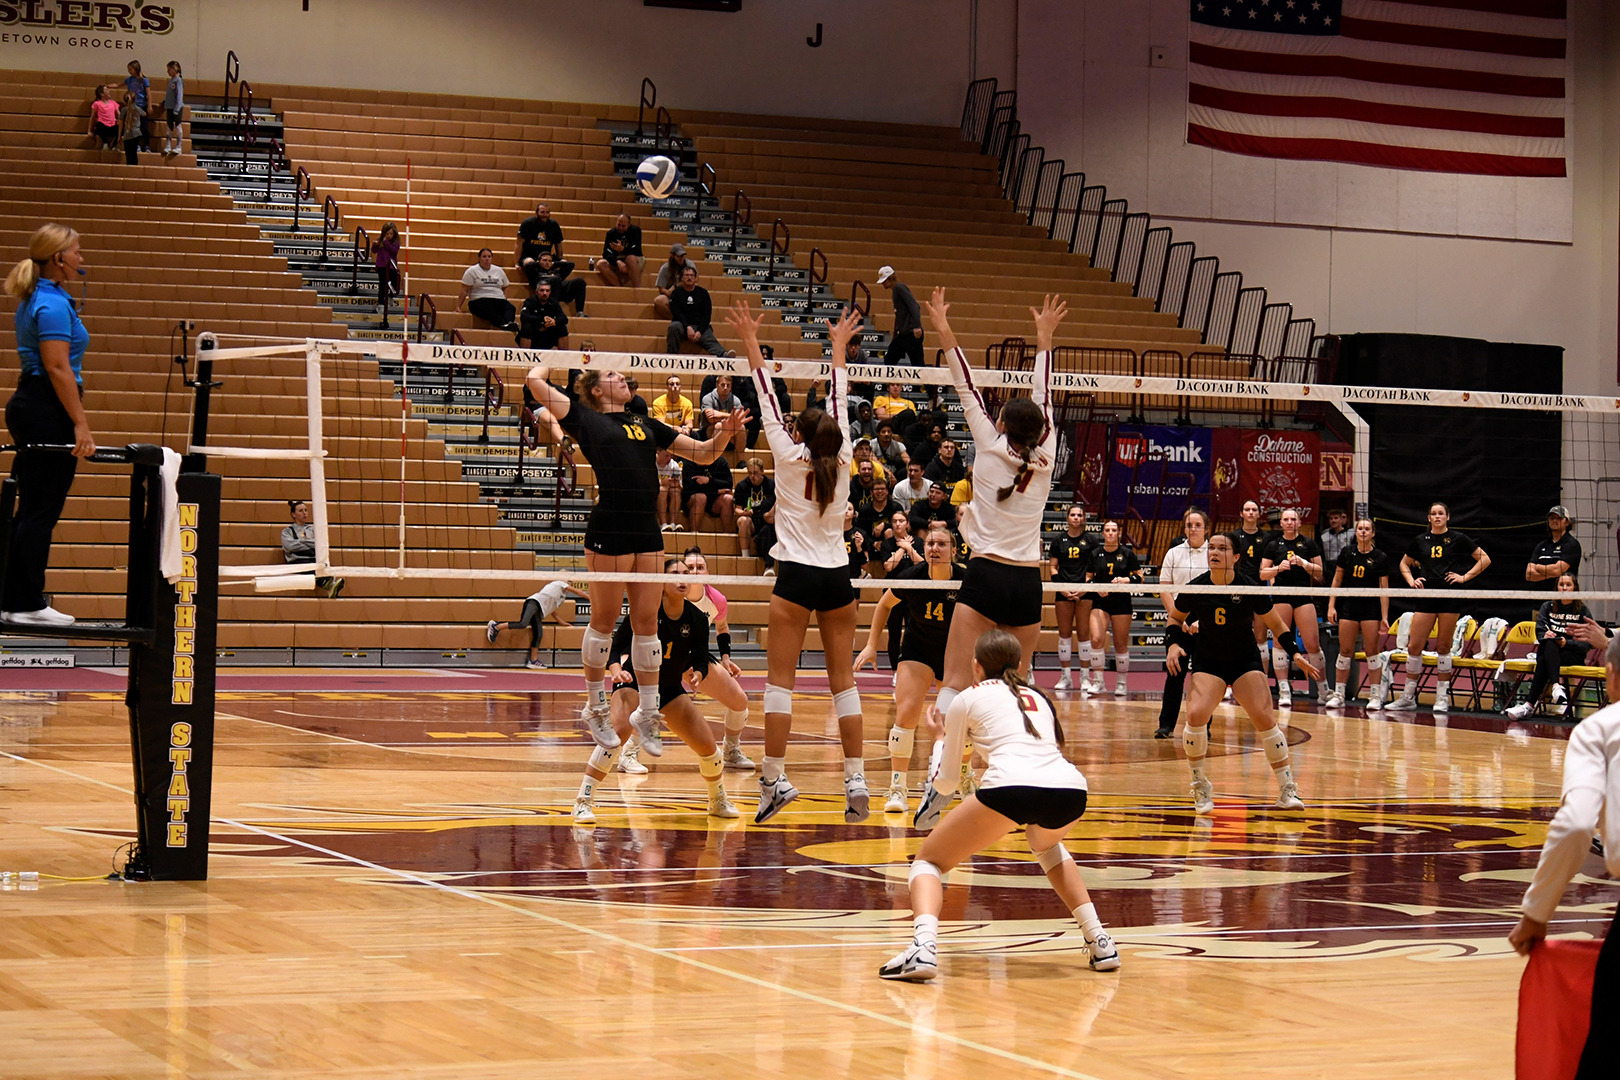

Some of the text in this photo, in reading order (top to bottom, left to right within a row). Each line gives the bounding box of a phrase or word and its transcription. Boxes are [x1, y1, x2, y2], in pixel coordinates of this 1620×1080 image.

[806, 22, 823, 48] J
[68, 38, 134, 49] GROCER
[432, 346, 542, 363] DACOTAH BANK
[630, 355, 736, 372] DACOTAH BANK
[820, 364, 921, 379] DOTAH BANK
[1065, 375, 1099, 387] BANK
[1177, 379, 1269, 394] DACOTAH BANK
[1343, 387, 1430, 401] DACOTAH BANK
[1501, 393, 1584, 407] DACOTAH BANK
[622, 424, 646, 440] 18
[1254, 434, 1305, 452] Dahme
[1248, 452, 1312, 464] CONSTRUCTION
[1321, 455, 1351, 488] N
[1068, 547, 1080, 558] 12
[1247, 545, 1253, 557] 4
[1431, 546, 1443, 558] 13
[1107, 563, 1114, 575] 7
[1353, 565, 1365, 578] 10
[171, 503, 199, 704] NORTHERN
[924, 602, 944, 621] 14
[1215, 608, 1226, 625] 6
[1517, 626, 1533, 637] NSU
[664, 641, 673, 659] 1
[166, 722, 192, 848] STATE
